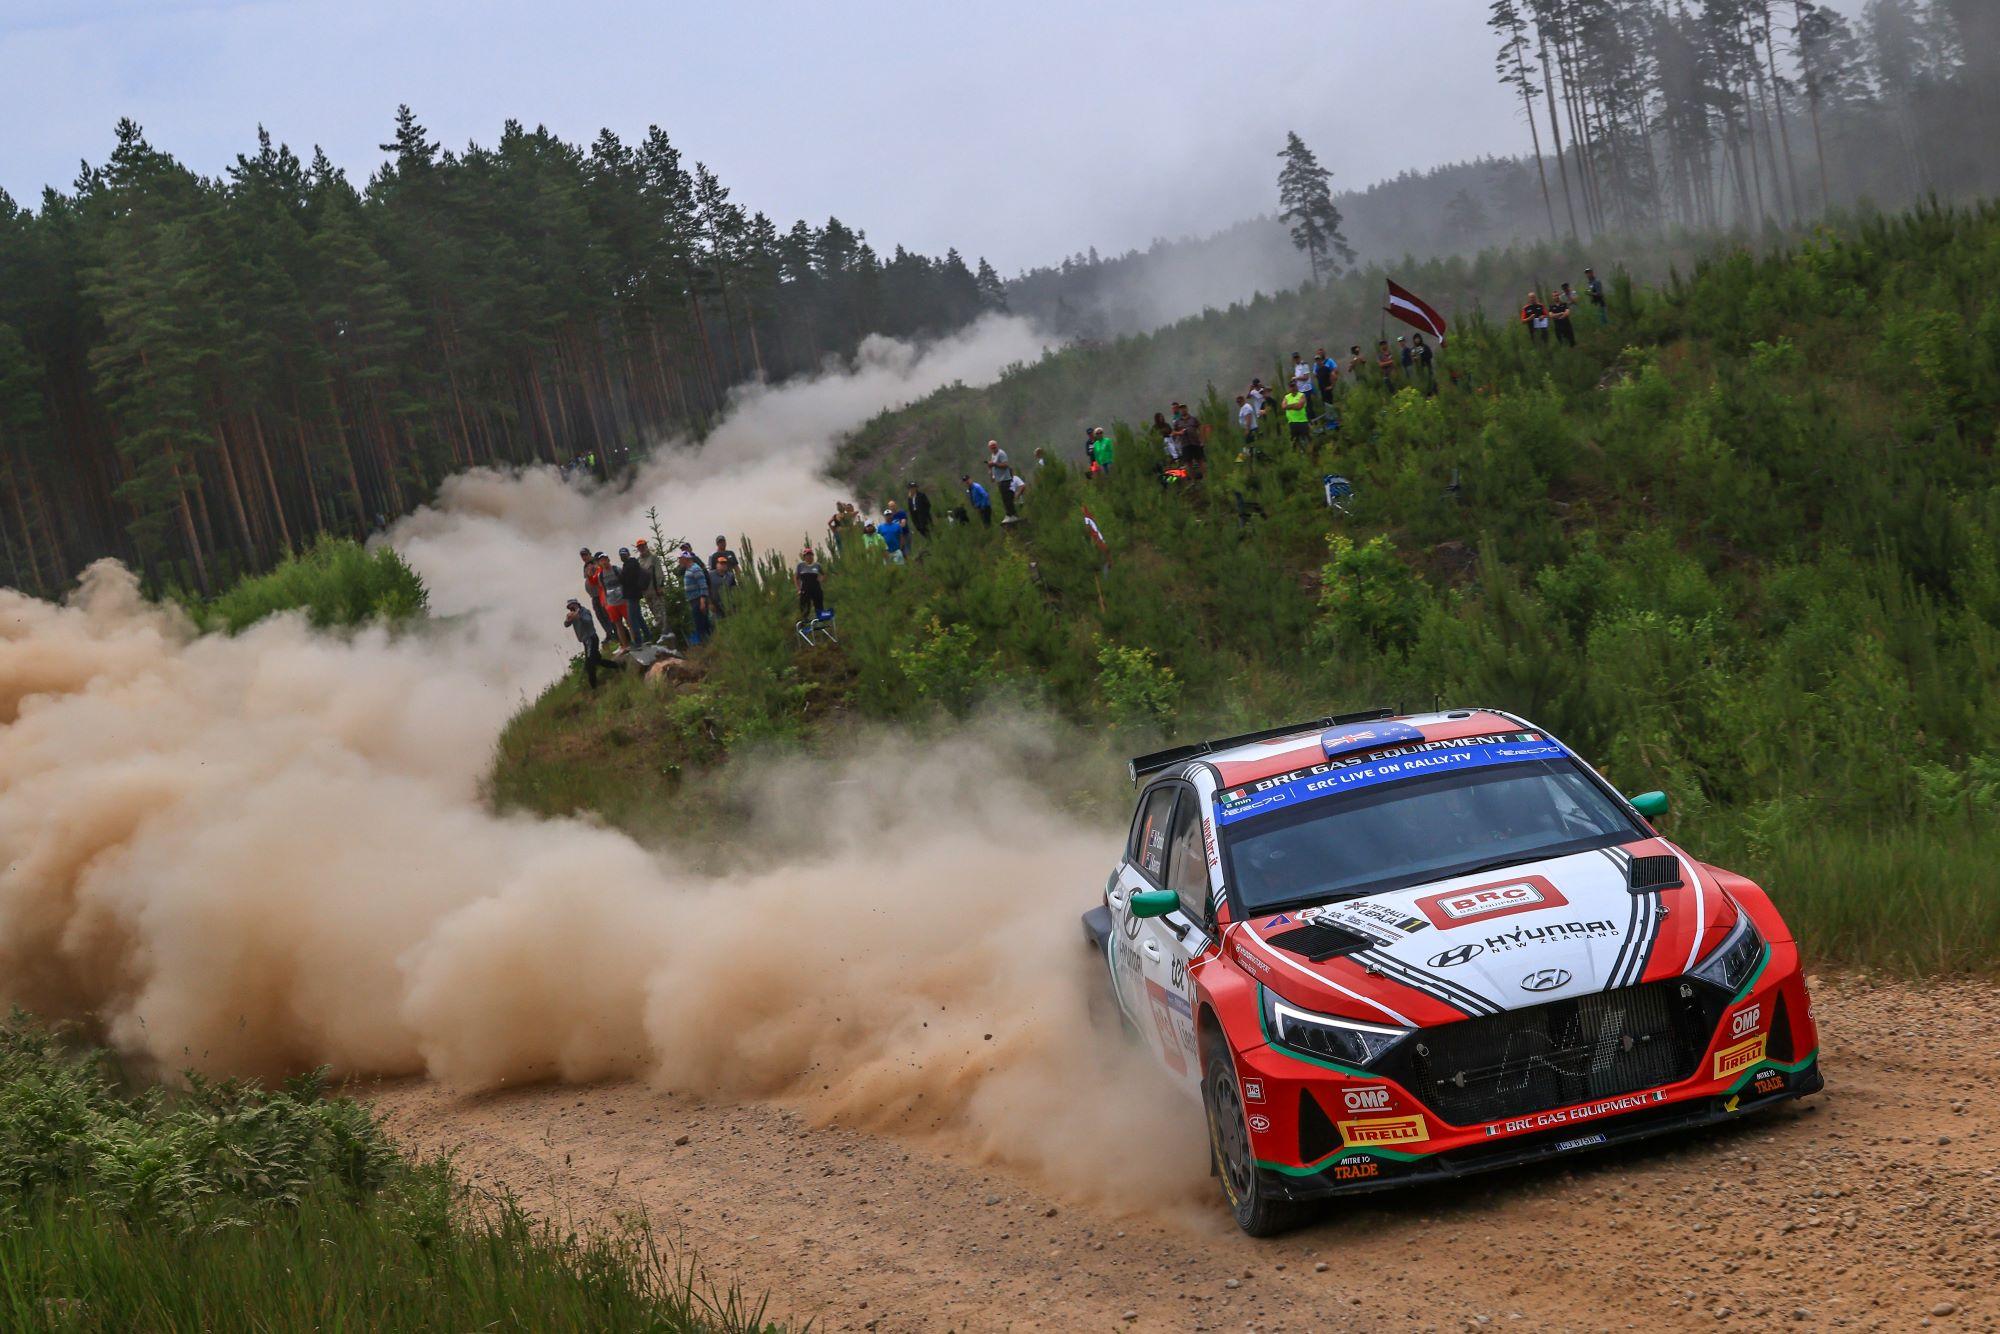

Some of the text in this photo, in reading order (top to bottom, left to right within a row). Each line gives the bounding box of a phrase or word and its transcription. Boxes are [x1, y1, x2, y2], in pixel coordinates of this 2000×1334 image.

[1255, 735, 1507, 792] BRC GAS EQUIPMENT
[1307, 753, 1472, 792] ERC LIVE ON RALLY.TV
[1234, 798, 1252, 806] min
[1203, 816, 1218, 870] www.brc.it
[1452, 888, 1527, 911] BRC
[1459, 896, 1531, 915] GAS EQUIPMENT
[1384, 907, 1409, 918] RALLY
[1403, 920, 1423, 931] 1
[1485, 919, 1617, 948] HYUNDAI
[1491, 929, 1620, 954] NEW ZEALAND
[1733, 1008, 1760, 1034] OMP
[1718, 1040, 1763, 1073] PIRELLI
[1754, 1076, 1784, 1094] TRADE
[1344, 1091, 1389, 1109] OMP
[1505, 1094, 1648, 1132] BRC GAS EQUIPMENT
[1346, 1121, 1420, 1142] PIRELLI
[1340, 1155, 1370, 1165] MITRE 10
[1334, 1164, 1378, 1179] TRADE
